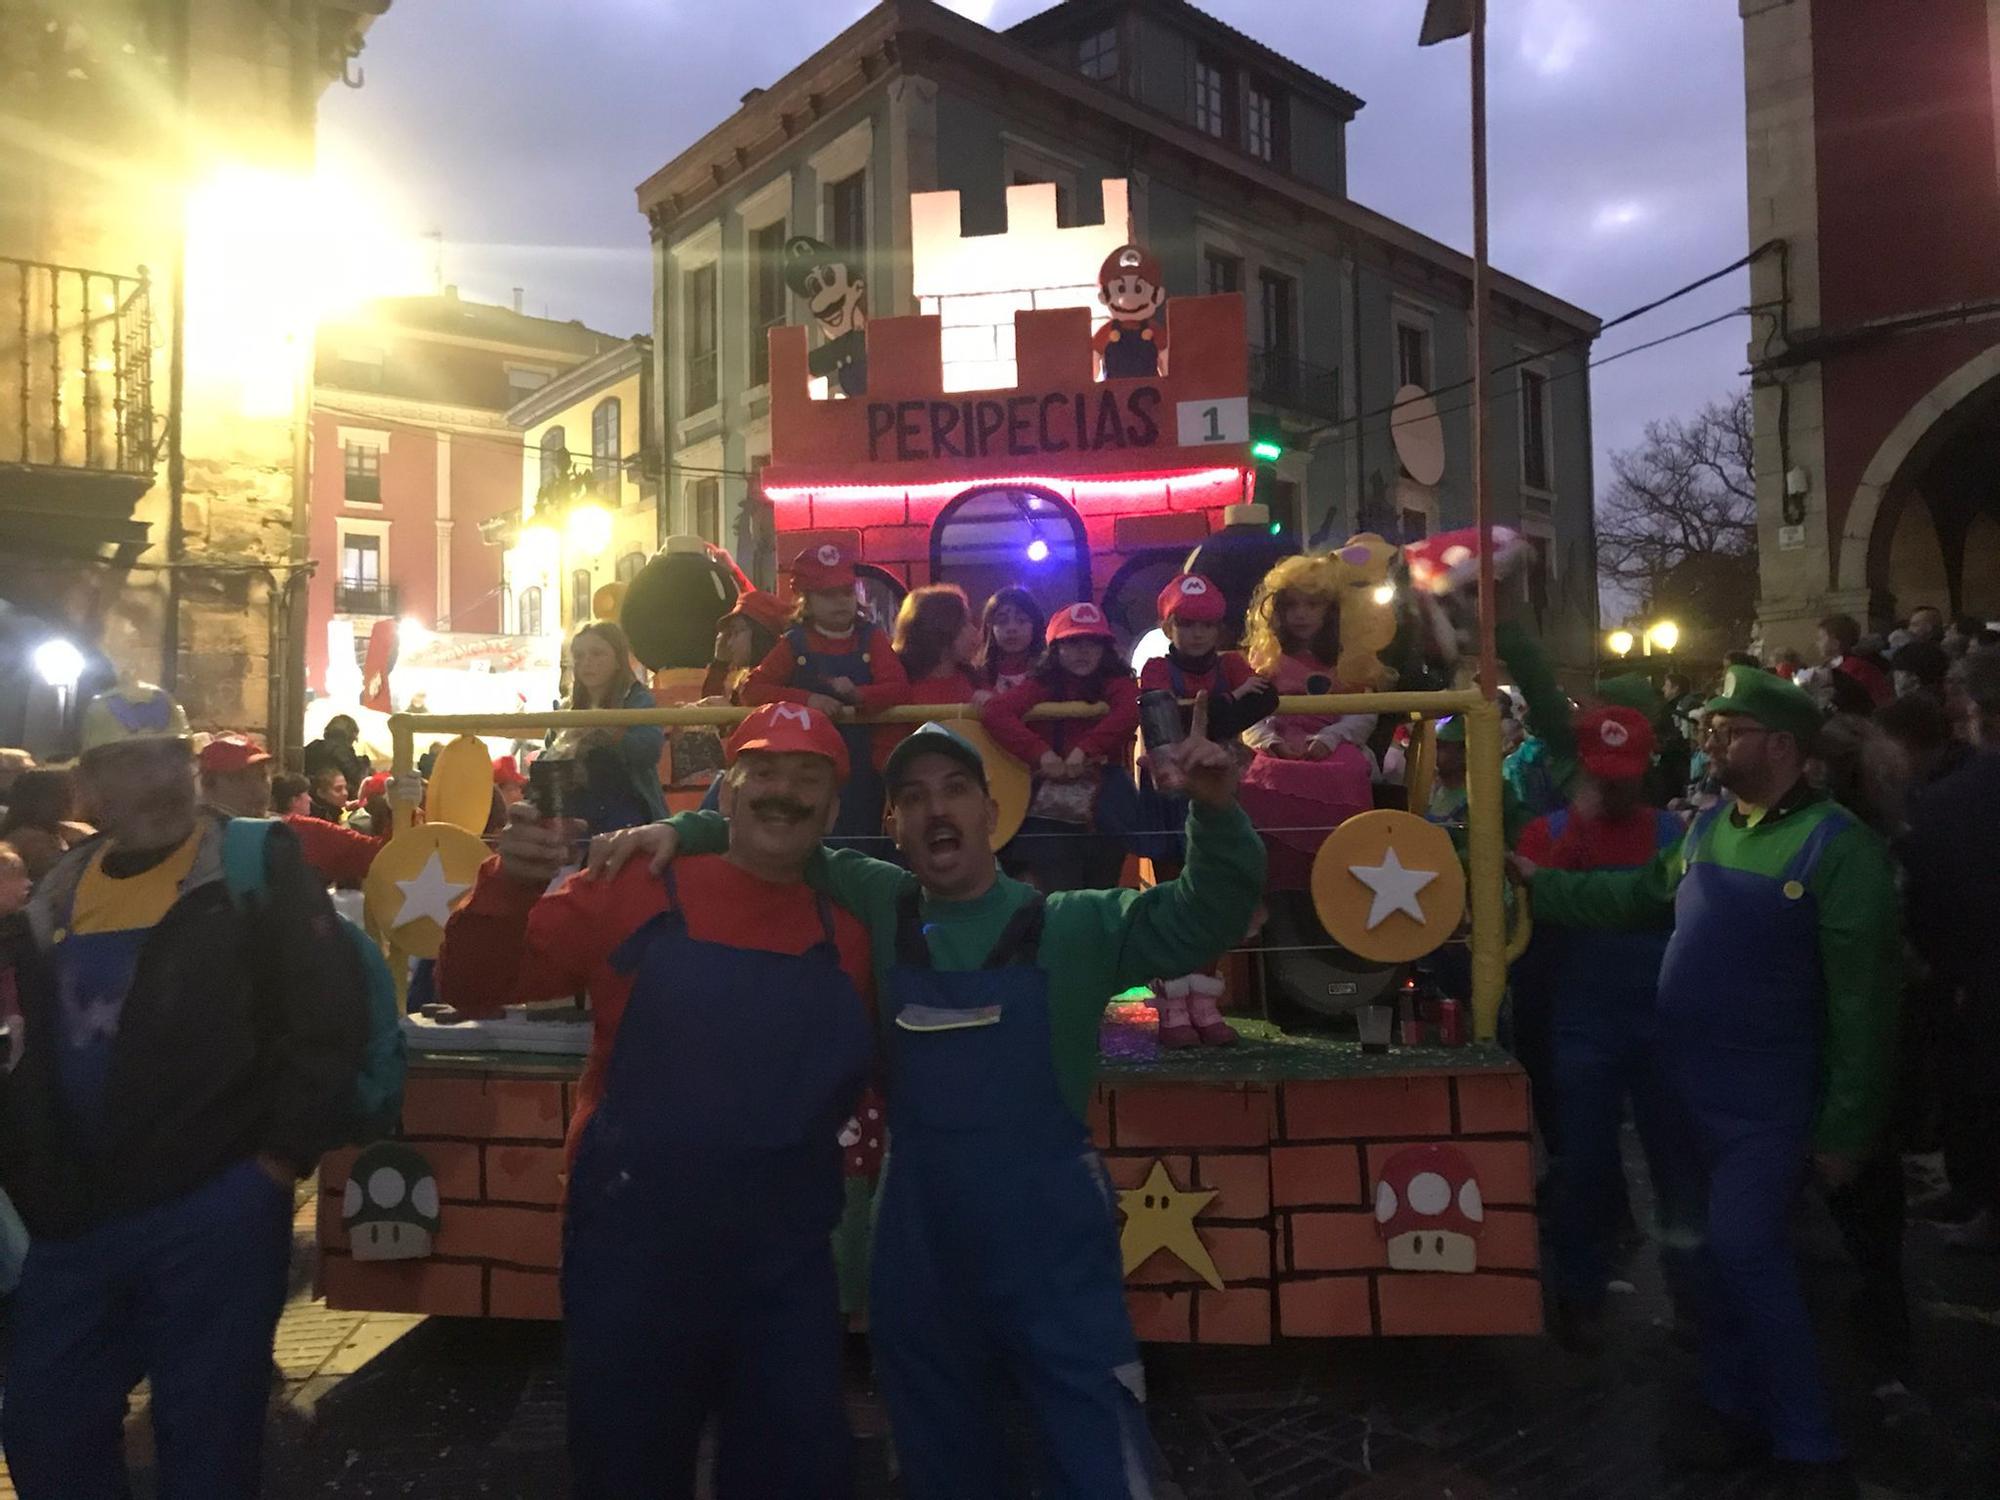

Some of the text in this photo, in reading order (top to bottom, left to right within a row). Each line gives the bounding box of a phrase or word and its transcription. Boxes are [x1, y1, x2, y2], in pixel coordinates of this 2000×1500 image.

[867, 385, 1162, 461] PERIPECIAS
[1202, 406, 1227, 441] 1
[1185, 581, 1204, 591] M
[1074, 605, 1095, 620] M
[769, 703, 812, 732] M
